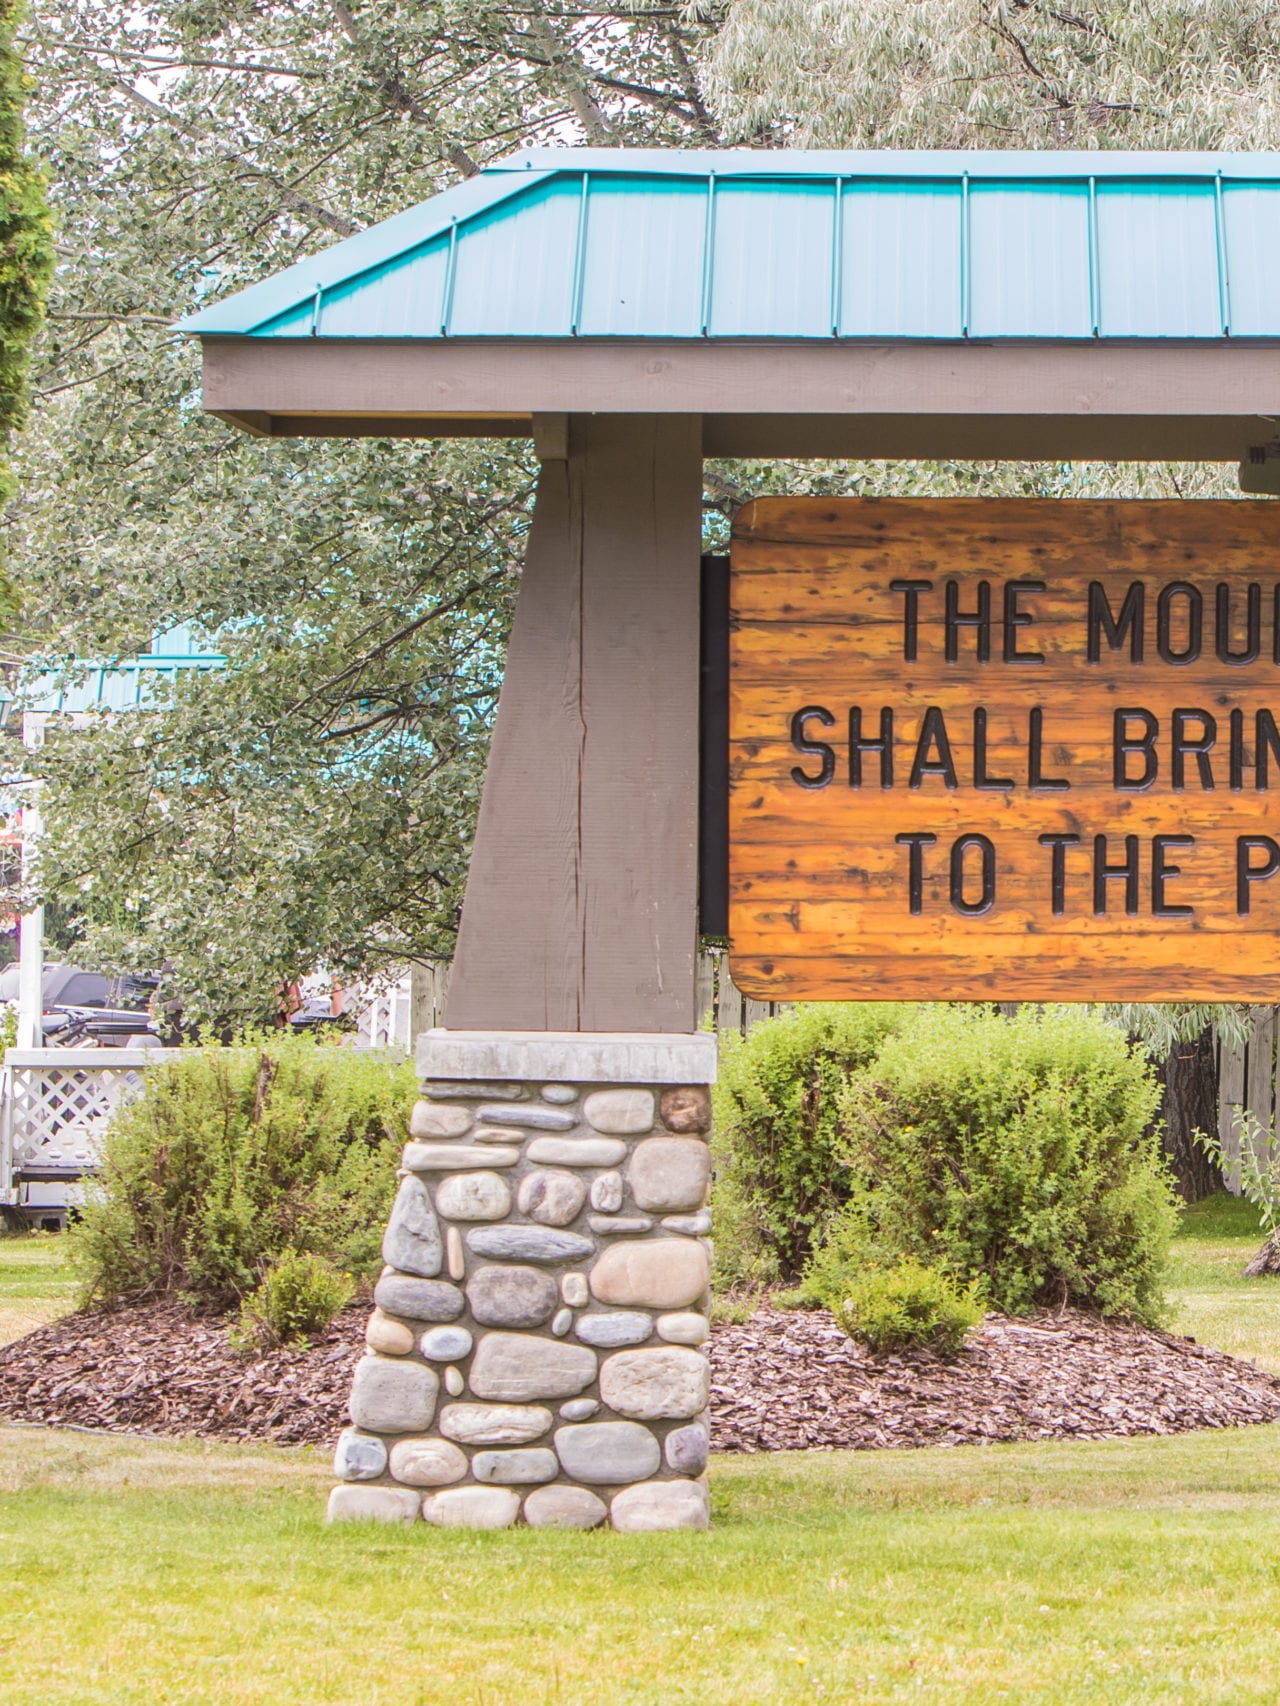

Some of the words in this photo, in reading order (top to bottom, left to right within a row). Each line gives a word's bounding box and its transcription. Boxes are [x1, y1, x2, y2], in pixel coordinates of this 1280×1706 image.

[890, 578, 1047, 665] THE
[790, 704, 1071, 790] SHALL
[895, 832, 996, 914] TO
[1039, 832, 1196, 914] THE
